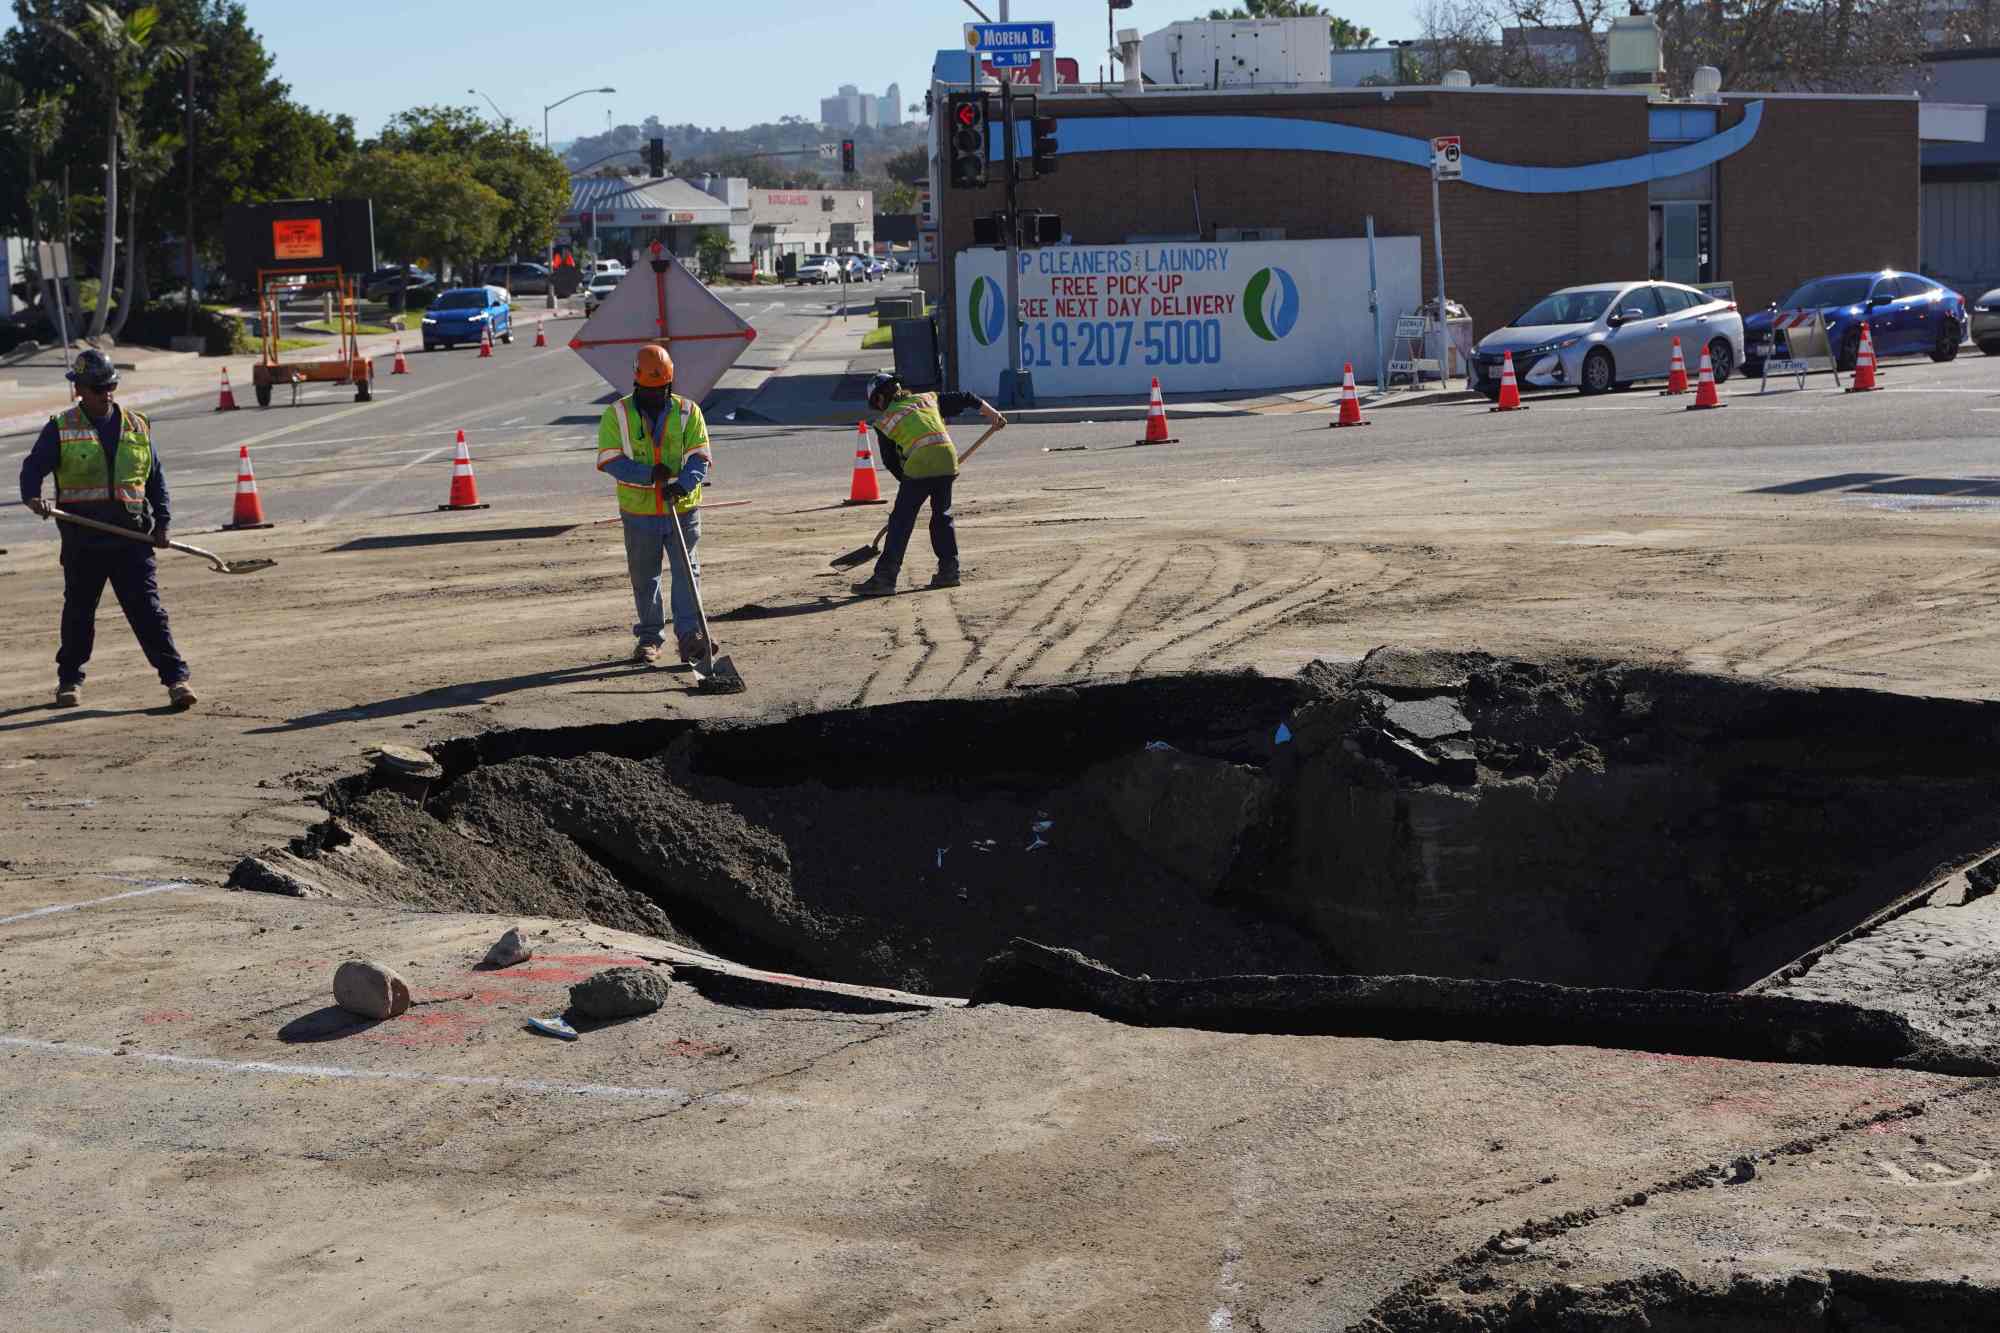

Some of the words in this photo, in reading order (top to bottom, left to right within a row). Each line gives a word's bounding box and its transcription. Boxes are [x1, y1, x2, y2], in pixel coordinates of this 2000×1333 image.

[984, 29, 1028, 46] MORENA
[1040, 250, 1132, 274] CLEANERS
[1145, 247, 1228, 272] LAUNDRY
[1051, 276, 1098, 296] FREE
[1106, 274, 1183, 295] PICK-UP
[1018, 298, 1048, 318] REE
[1055, 297, 1098, 318] NEXT
[1107, 296, 1141, 317] DAY
[1151, 294, 1235, 316] DELIVERY
[1021, 319, 1220, 366] 619-207-5000
